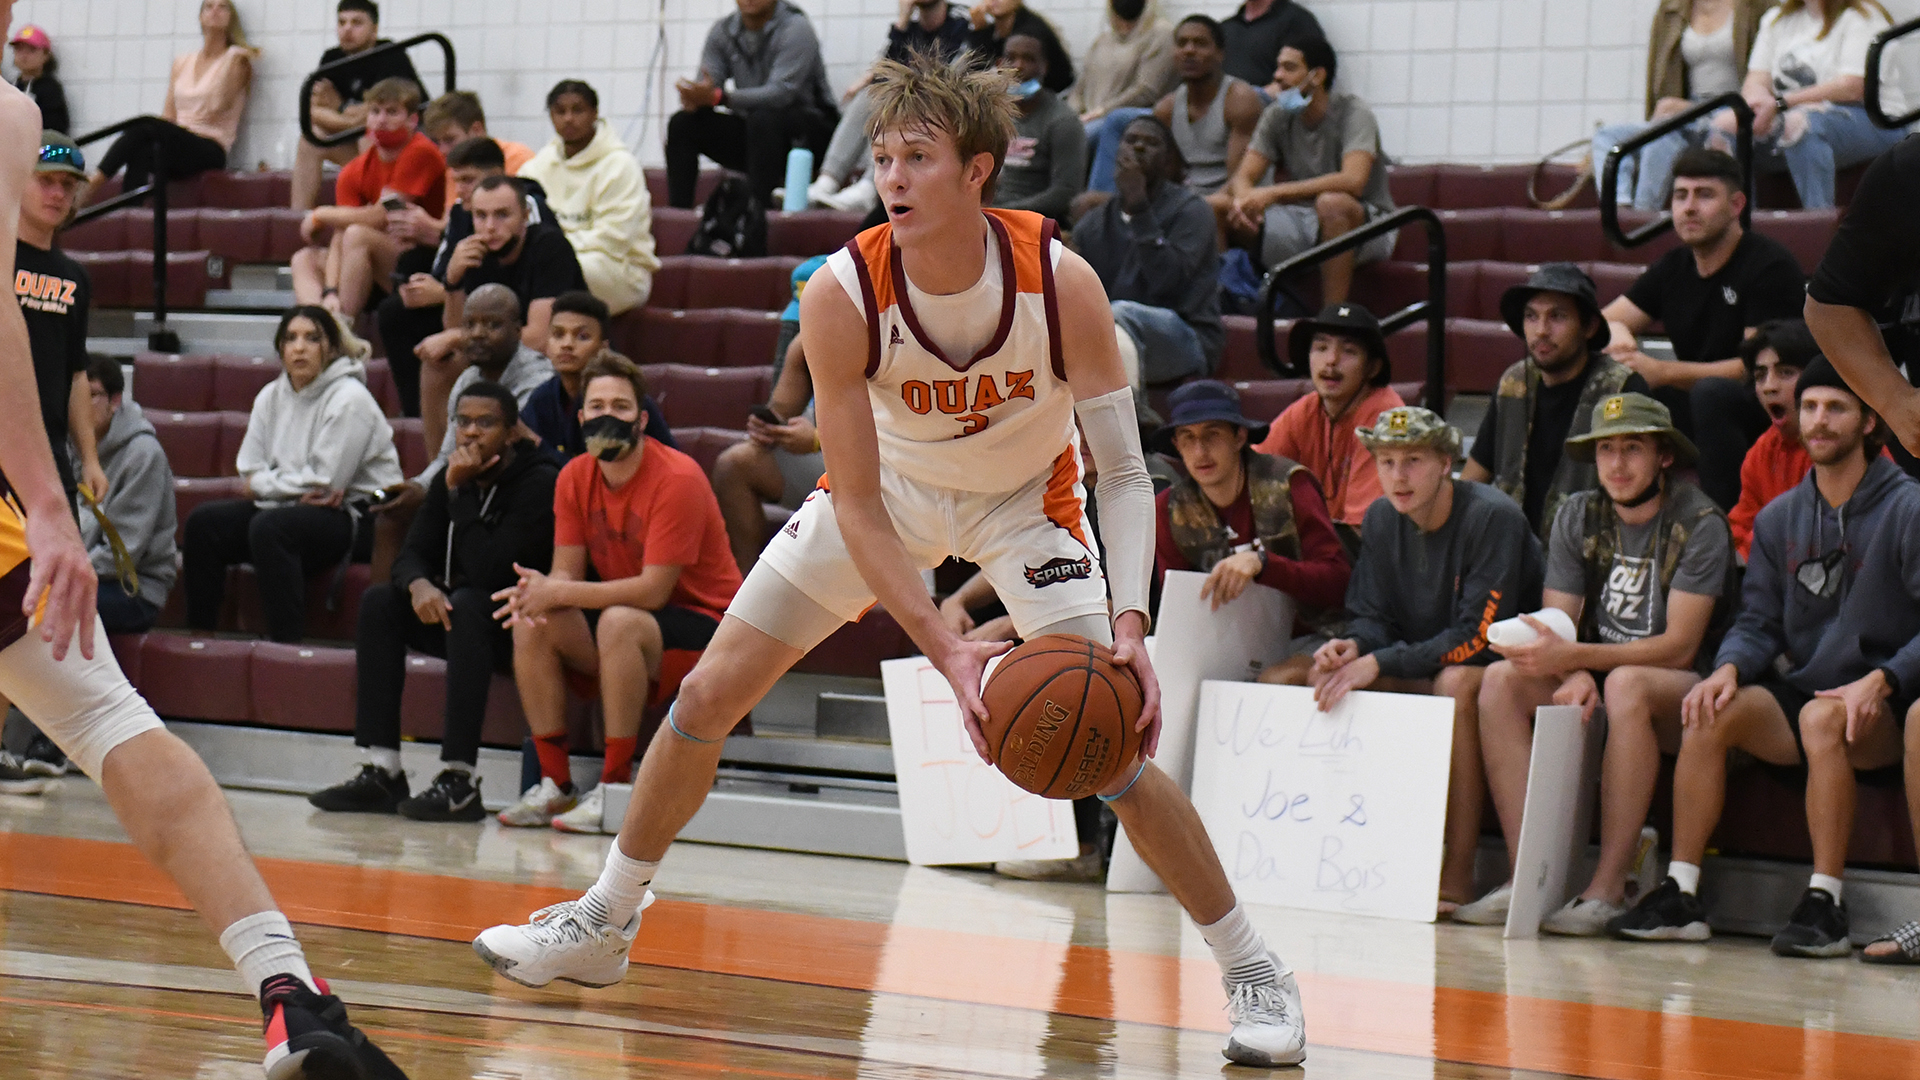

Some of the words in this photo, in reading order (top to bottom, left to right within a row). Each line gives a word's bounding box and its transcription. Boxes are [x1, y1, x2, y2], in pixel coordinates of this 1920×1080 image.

[15, 268, 77, 305] OUAZ
[901, 369, 1036, 415] OUAZ
[1033, 563, 1087, 583] SPIRIT
[1012, 699, 1071, 791] PALDING
[1212, 694, 1287, 757] We
[1064, 727, 1102, 794] EGACY
[1242, 769, 1313, 823] Joe
[1234, 830, 1286, 881] Da
